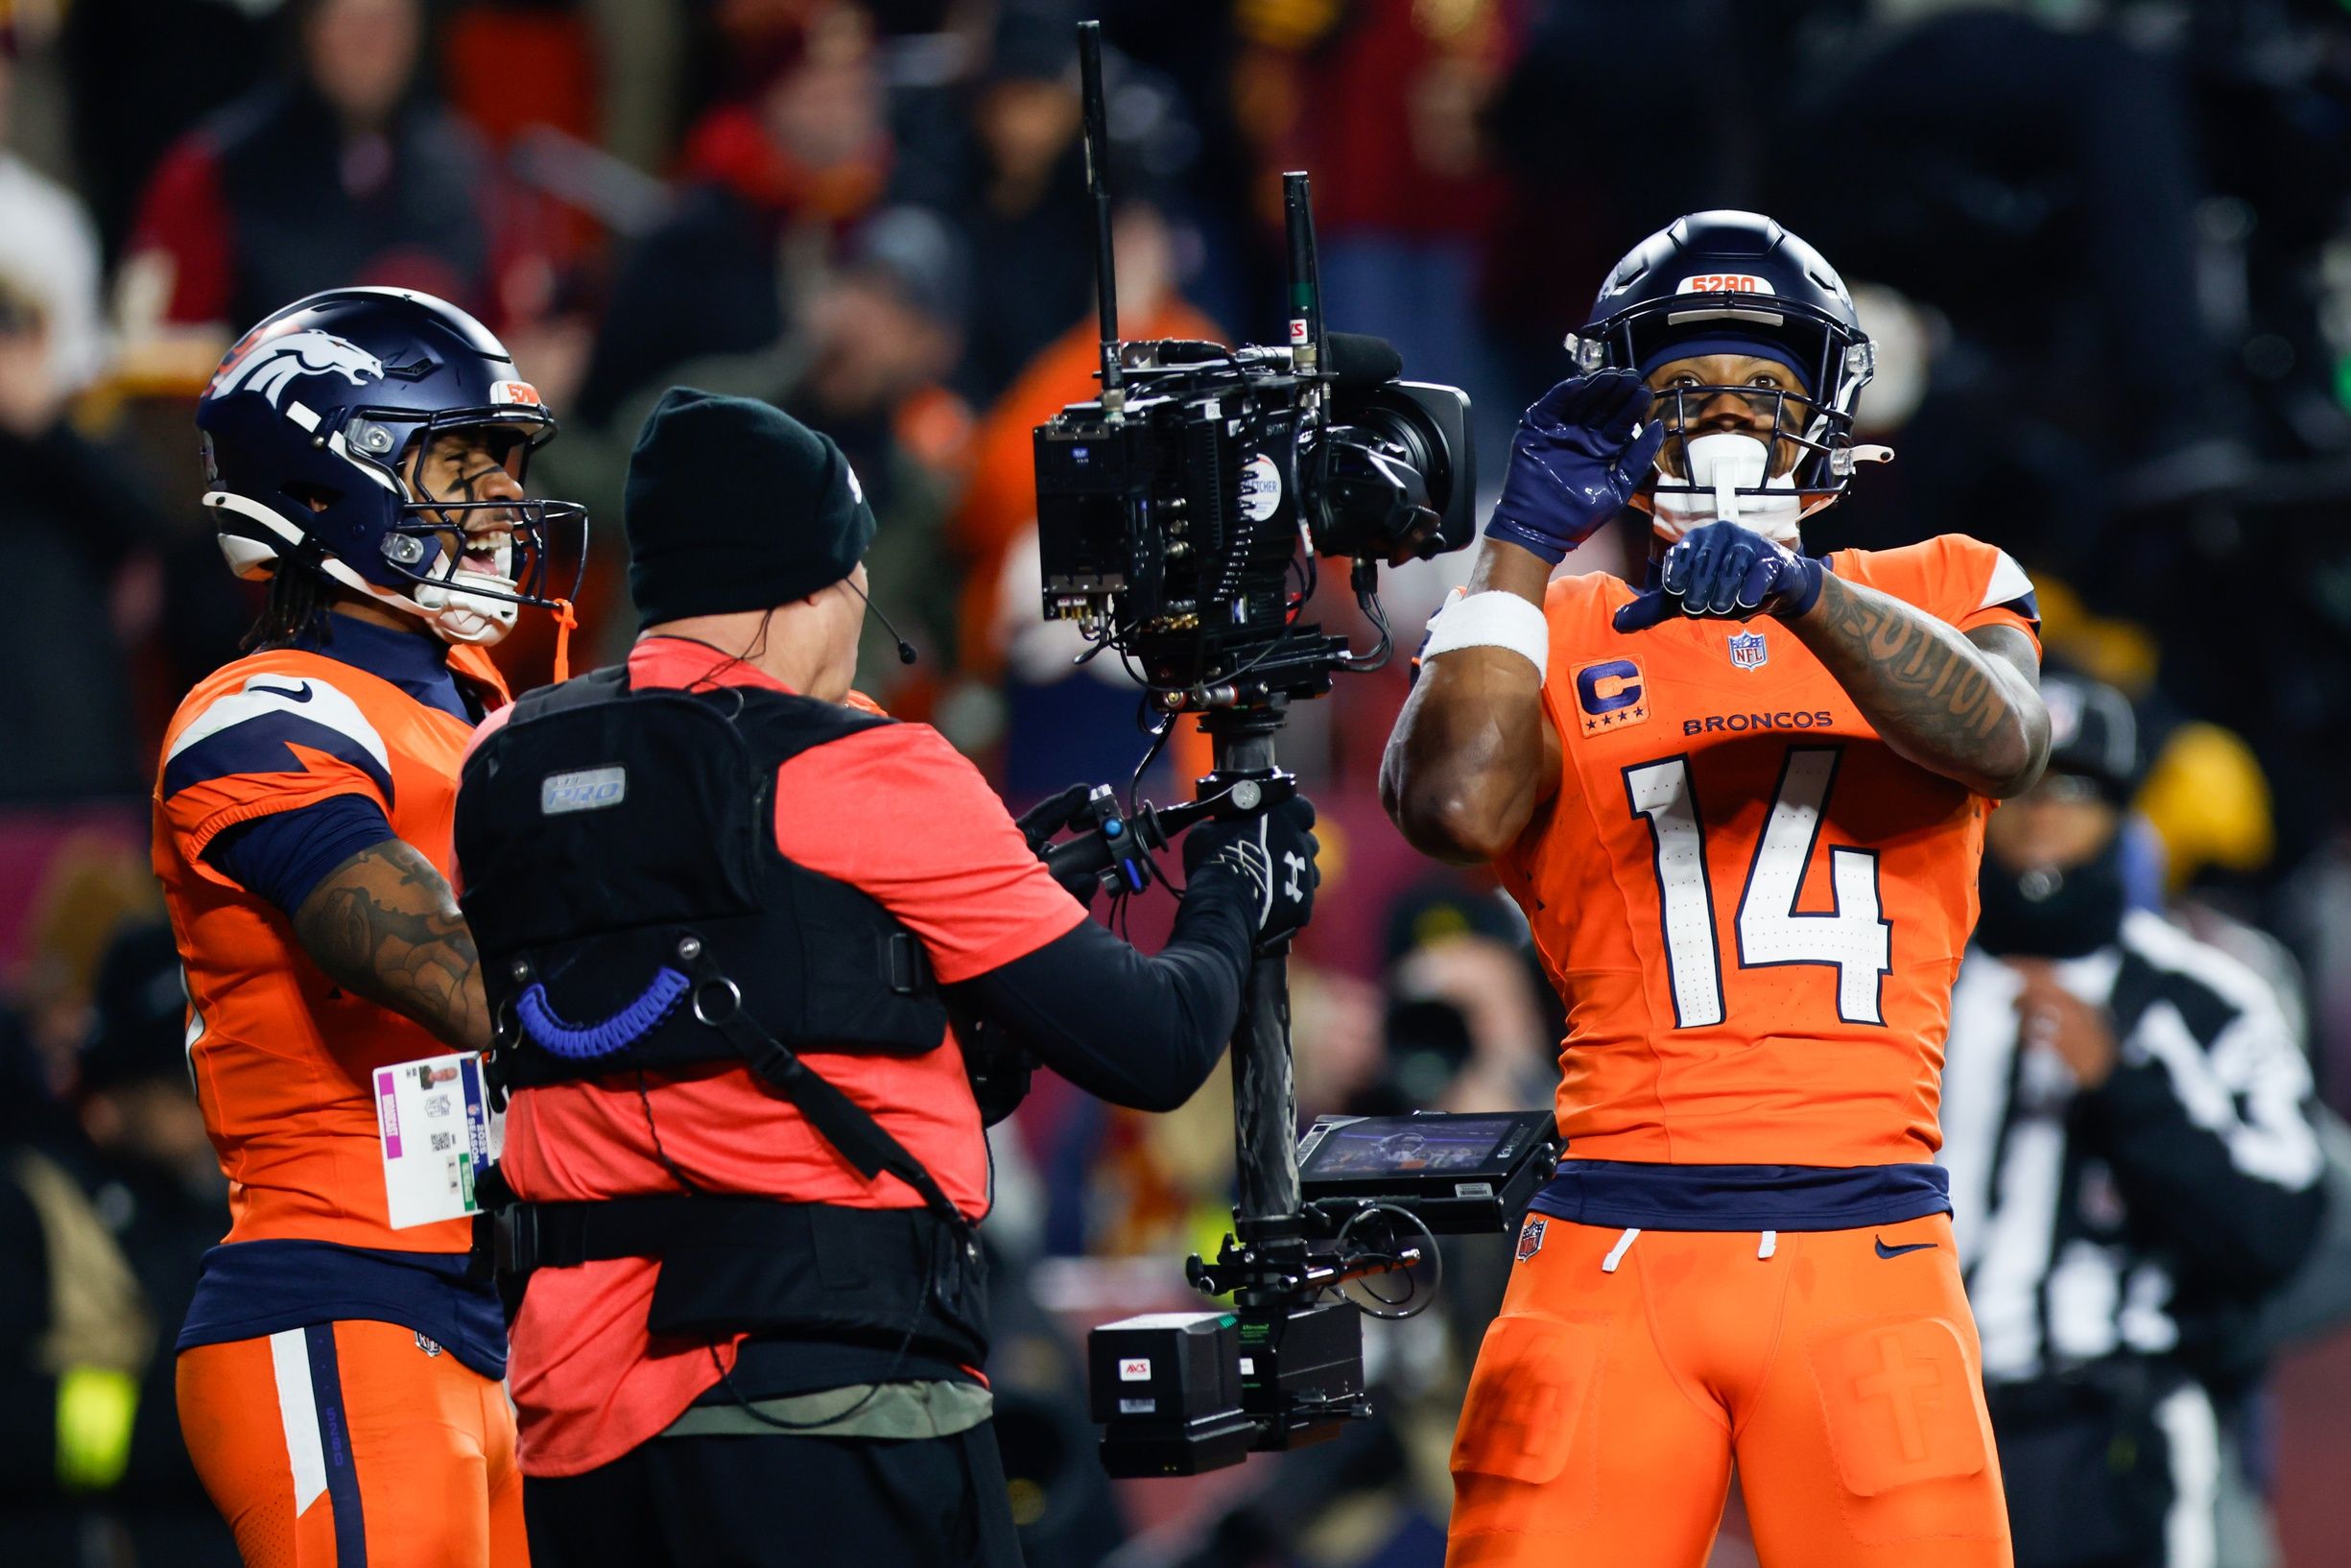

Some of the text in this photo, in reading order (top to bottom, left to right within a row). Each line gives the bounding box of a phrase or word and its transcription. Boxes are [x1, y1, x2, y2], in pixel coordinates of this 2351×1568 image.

[1692, 275, 1755, 293] 5280
[1267, 422, 1292, 437] SONY
[1735, 648, 1763, 663] NFL
[1577, 659, 1642, 716] C
[1683, 711, 1833, 737] BRONCOS
[1621, 744, 1894, 1030] 14
[468, 1117, 480, 1165] SEASON
[326, 1407, 344, 1467] 5280
